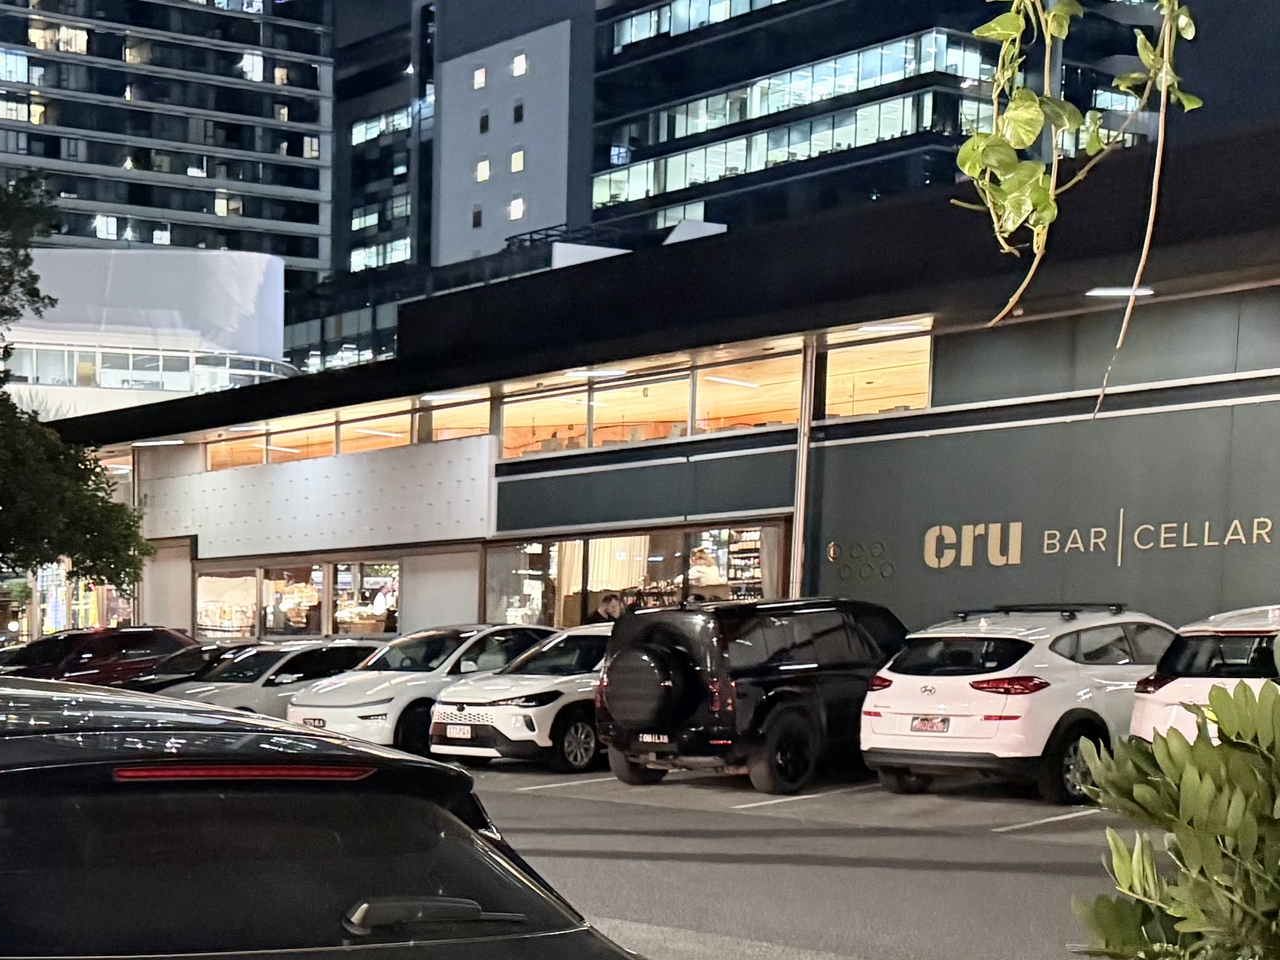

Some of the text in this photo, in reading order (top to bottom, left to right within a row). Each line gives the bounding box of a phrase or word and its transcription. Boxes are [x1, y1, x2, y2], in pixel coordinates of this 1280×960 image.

[923, 517, 1273, 569] cru BAR CELLAR
